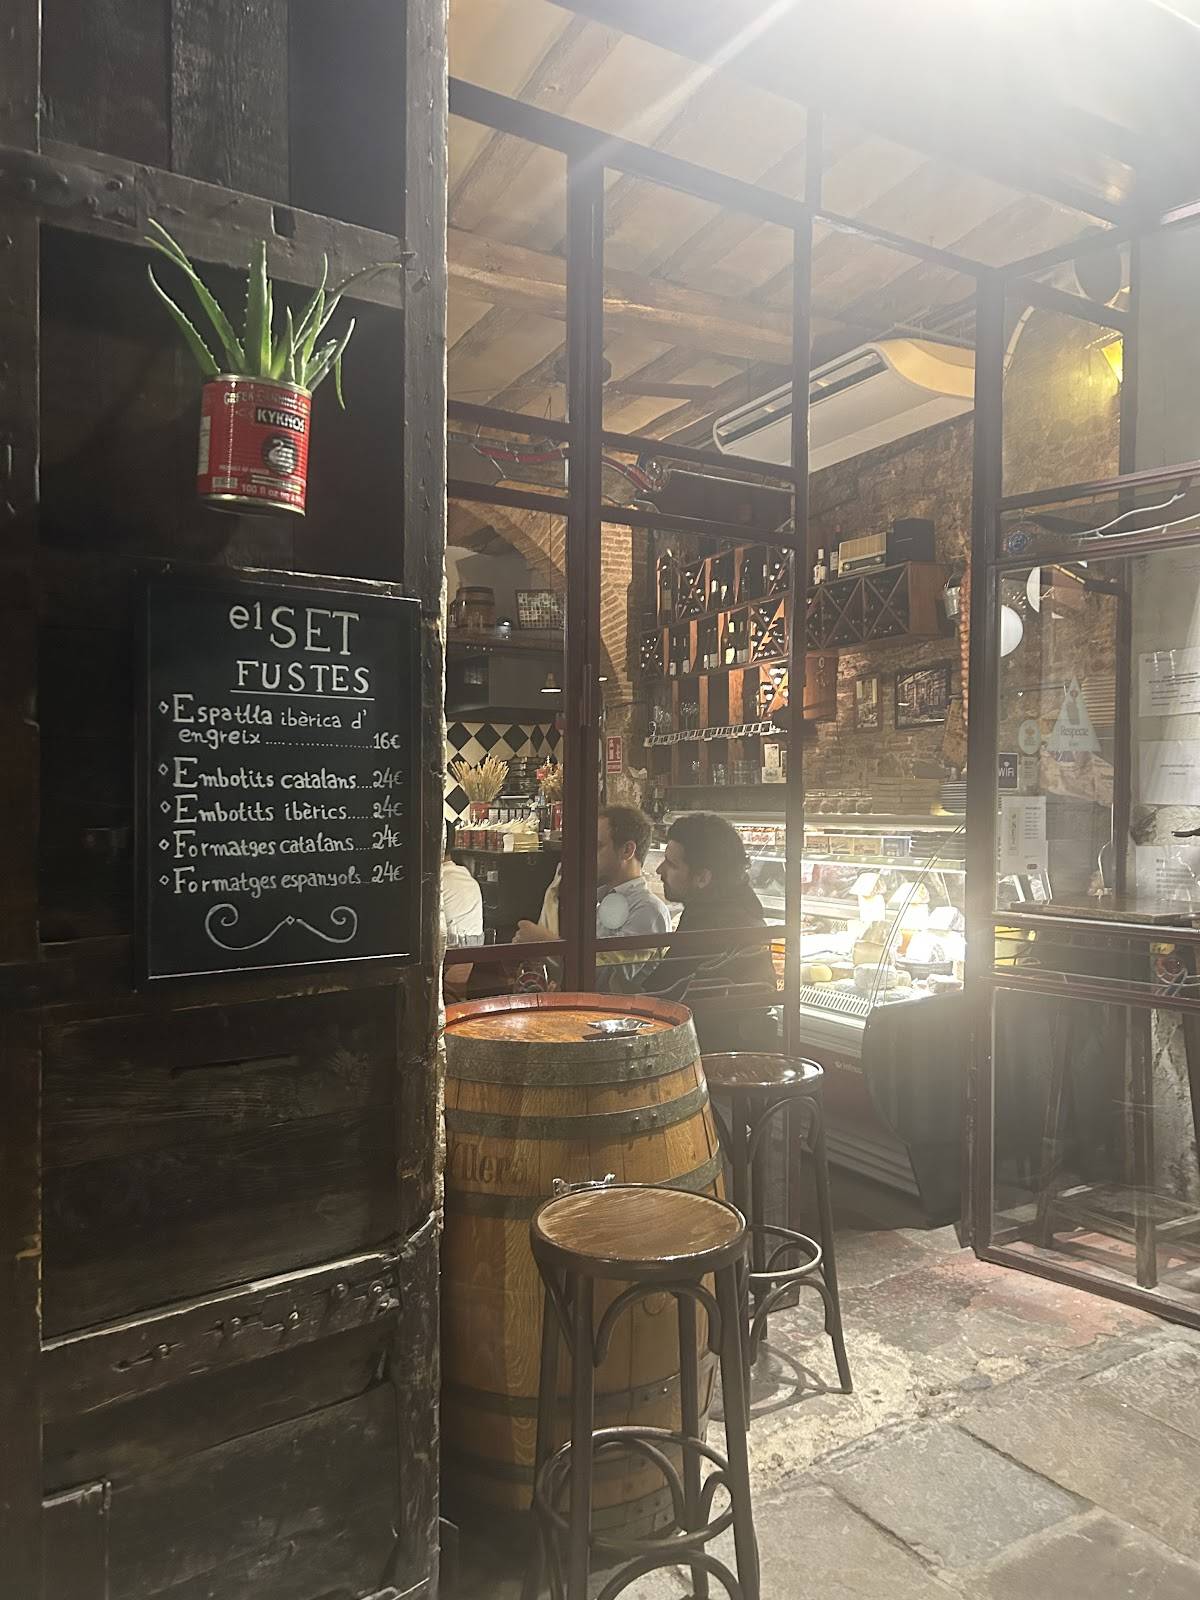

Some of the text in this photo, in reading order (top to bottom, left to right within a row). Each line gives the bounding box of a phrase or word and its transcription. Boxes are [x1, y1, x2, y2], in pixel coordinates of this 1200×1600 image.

[228, 601, 360, 656] el SET
[236, 659, 370, 694] FUSTES
[172, 693, 273, 726] Espatlla
[280, 707, 342, 729] ibèrica
[178, 727, 261, 750] engreix
[172, 756, 274, 789] Embotits
[280, 767, 357, 790] catalans
[174, 793, 274, 824] Embotits
[285, 801, 347, 822] ibèrics
[173, 829, 276, 859] Formatges
[280, 832, 354, 855] catalans
[173, 865, 276, 899] Formatges
[280, 866, 361, 892] espanyols
